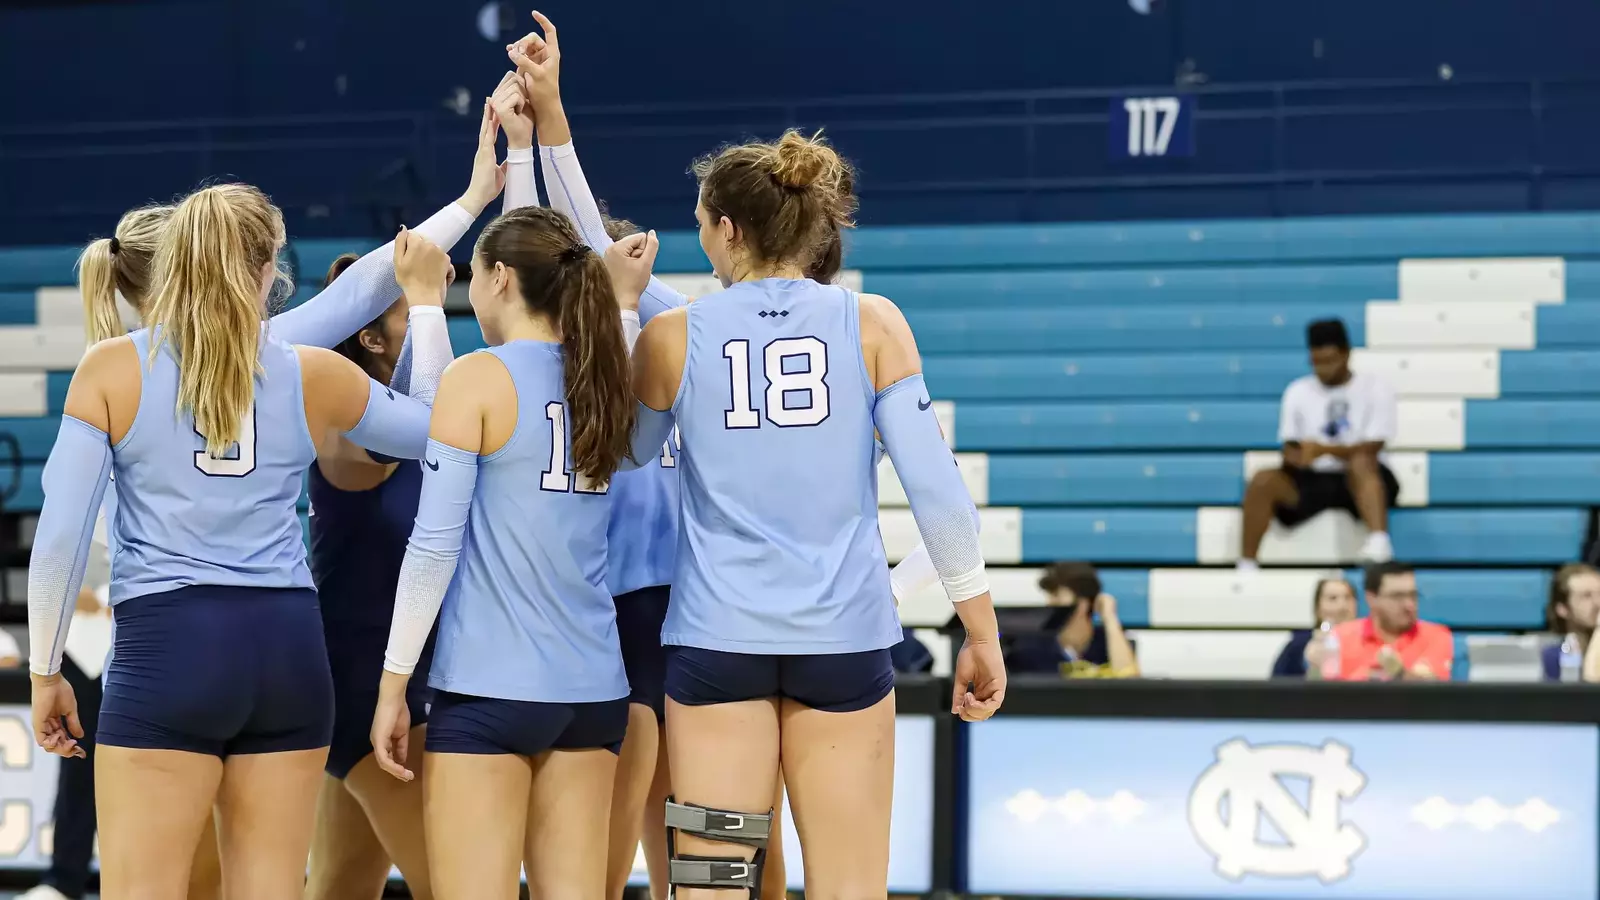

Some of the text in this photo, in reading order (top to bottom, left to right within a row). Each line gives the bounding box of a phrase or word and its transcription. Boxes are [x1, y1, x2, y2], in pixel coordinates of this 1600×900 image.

[1124, 96, 1181, 157] 117
[723, 335, 831, 429] 18
[540, 400, 610, 496] 1
